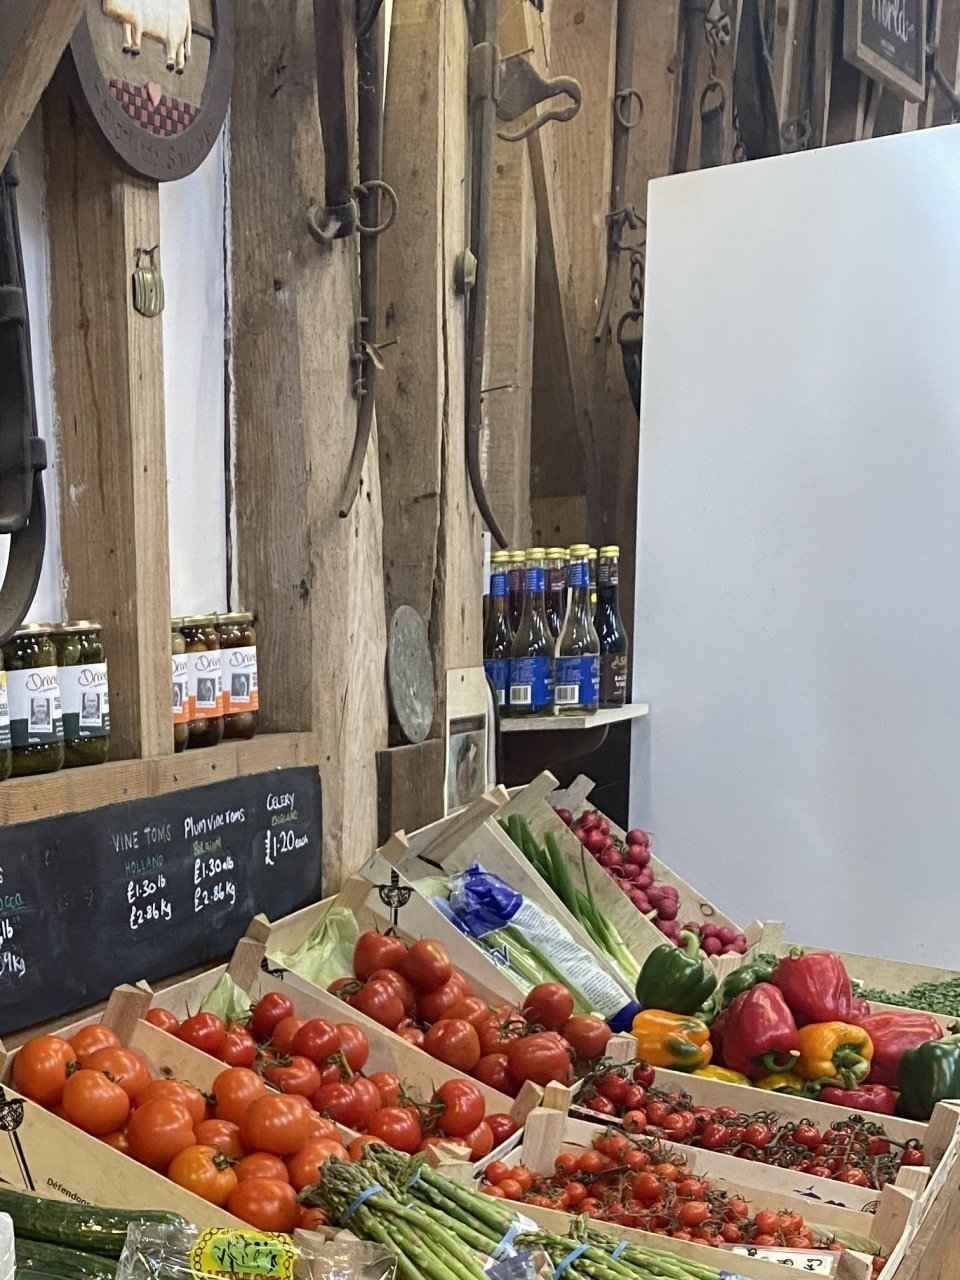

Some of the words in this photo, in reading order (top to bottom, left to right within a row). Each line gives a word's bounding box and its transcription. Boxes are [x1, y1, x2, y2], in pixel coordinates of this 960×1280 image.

[111, 831, 139, 852] VINE
[144, 824, 172, 845] TOMS
[124, 854, 164, 876] HOLLAND
[127, 880, 157, 903] £1.30
[194, 886, 225, 912] £2.86
[130, 905, 159, 930] £2.86
